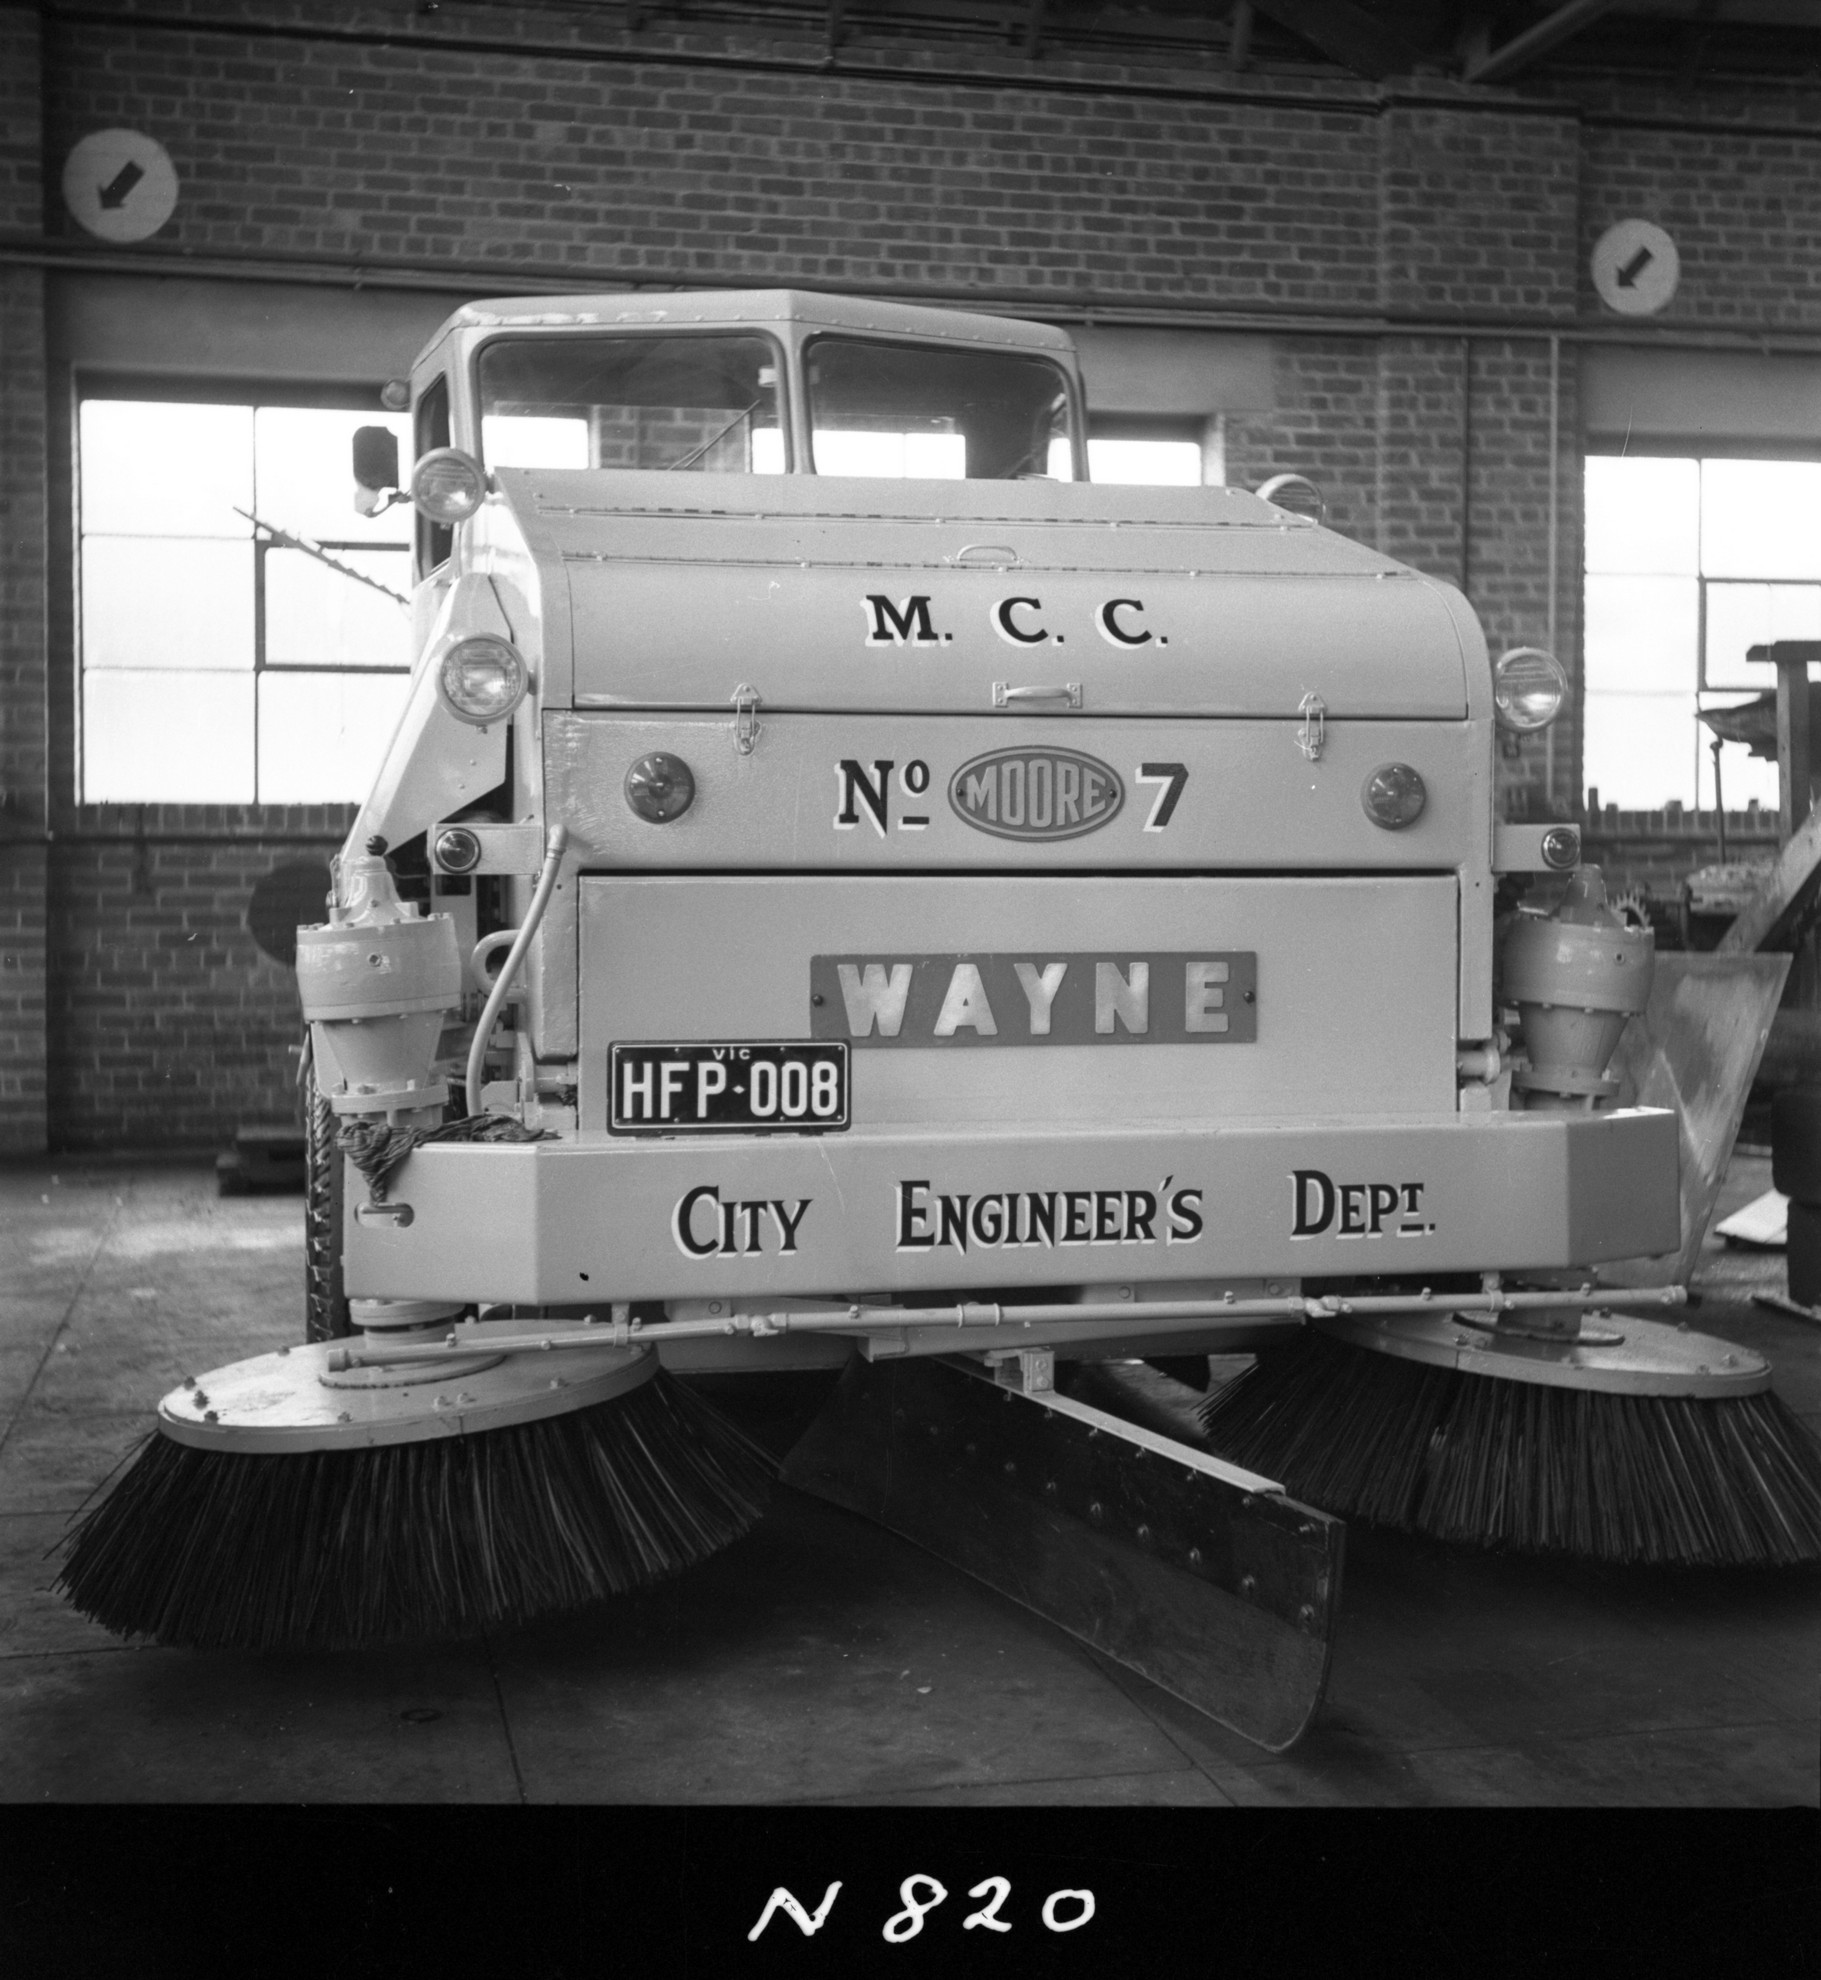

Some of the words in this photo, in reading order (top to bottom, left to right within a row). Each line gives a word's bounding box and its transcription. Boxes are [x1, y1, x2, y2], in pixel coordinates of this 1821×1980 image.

[862, 594, 953, 645] M.
[992, 596, 1065, 647] C.
[1096, 598, 1169, 648] C.
[965, 758, 1107, 828] MOORE
[1136, 762, 1190, 832] 7
[836, 961, 1230, 1037] WAYNE
